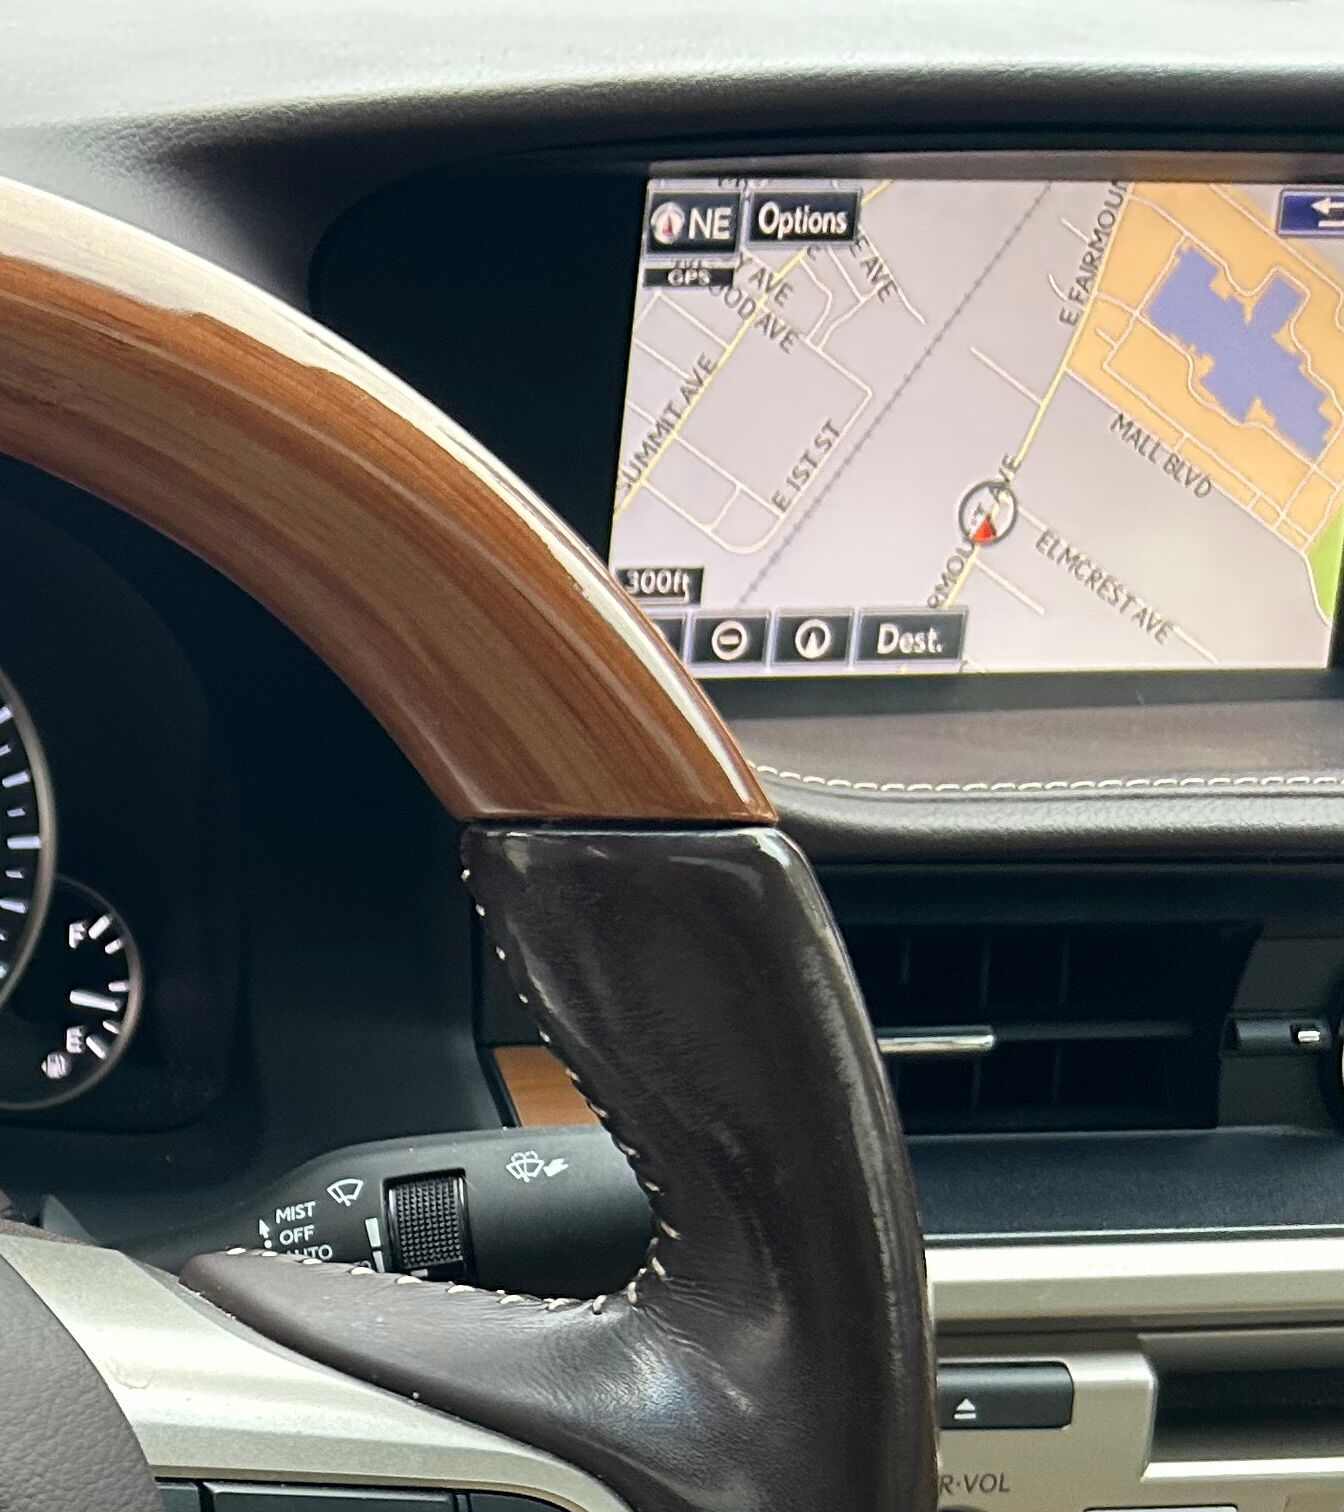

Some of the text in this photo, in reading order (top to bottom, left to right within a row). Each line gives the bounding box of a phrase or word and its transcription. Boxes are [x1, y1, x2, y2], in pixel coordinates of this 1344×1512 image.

[688, 207, 732, 240] NE
[758, 201, 849, 240] Options
[667, 269, 710, 286] GPS
[749, 267, 794, 307] AVE
[863, 256, 898, 303] AVE
[754, 310, 802, 354] AVE
[679, 352, 718, 406] AVE
[815, 418, 842, 452] ST
[1109, 413, 1213, 499] MALL BLVD
[1035, 529, 1175, 645] ELMCREST AVE
[877, 623, 943, 655] Dest.
[68, 922, 87, 949] F
[65, 1026, 85, 1055] E
[275, 1200, 316, 1224] MIST
[279, 1224, 315, 1245] OFF
